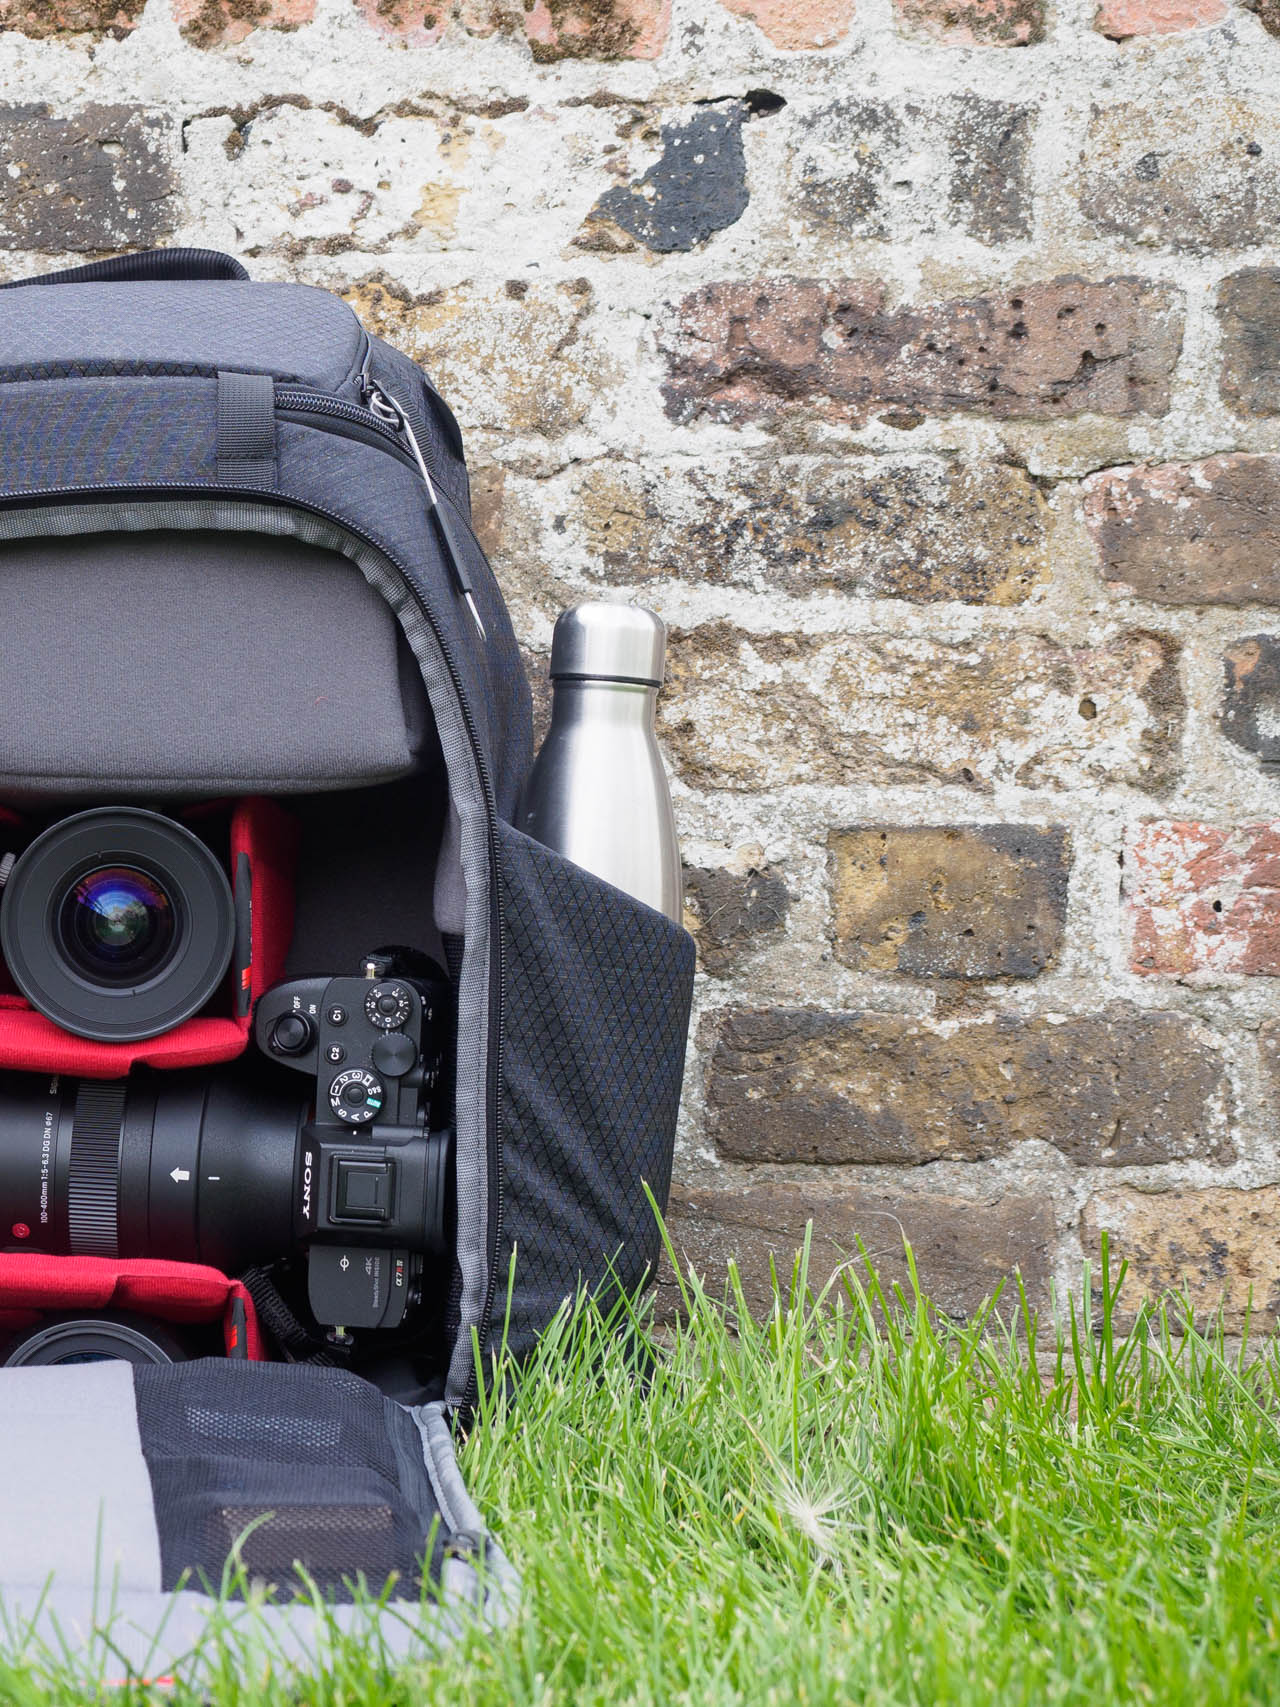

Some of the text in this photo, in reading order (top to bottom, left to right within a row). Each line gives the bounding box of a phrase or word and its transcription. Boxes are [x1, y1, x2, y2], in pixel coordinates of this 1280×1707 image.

[293, 995, 301, 1009] OFF
[309, 1004, 316, 1014] ON
[332, 1009, 341, 1021] C1
[331, 1047, 340, 1060] C2
[330, 1096, 341, 1107] M
[338, 1109, 348, 1118] S
[351, 1113, 360, 1121] A
[363, 1110, 373, 1119] P
[43, 1127, 52, 1139] DN
[42, 1140, 51, 1152] DG
[41, 1153, 50, 1179] 1:5-6.3
[302, 1151, 313, 1220] SONY
[40, 1181, 49, 1224] 100-400mm
[365, 1256, 373, 1276] 4K
